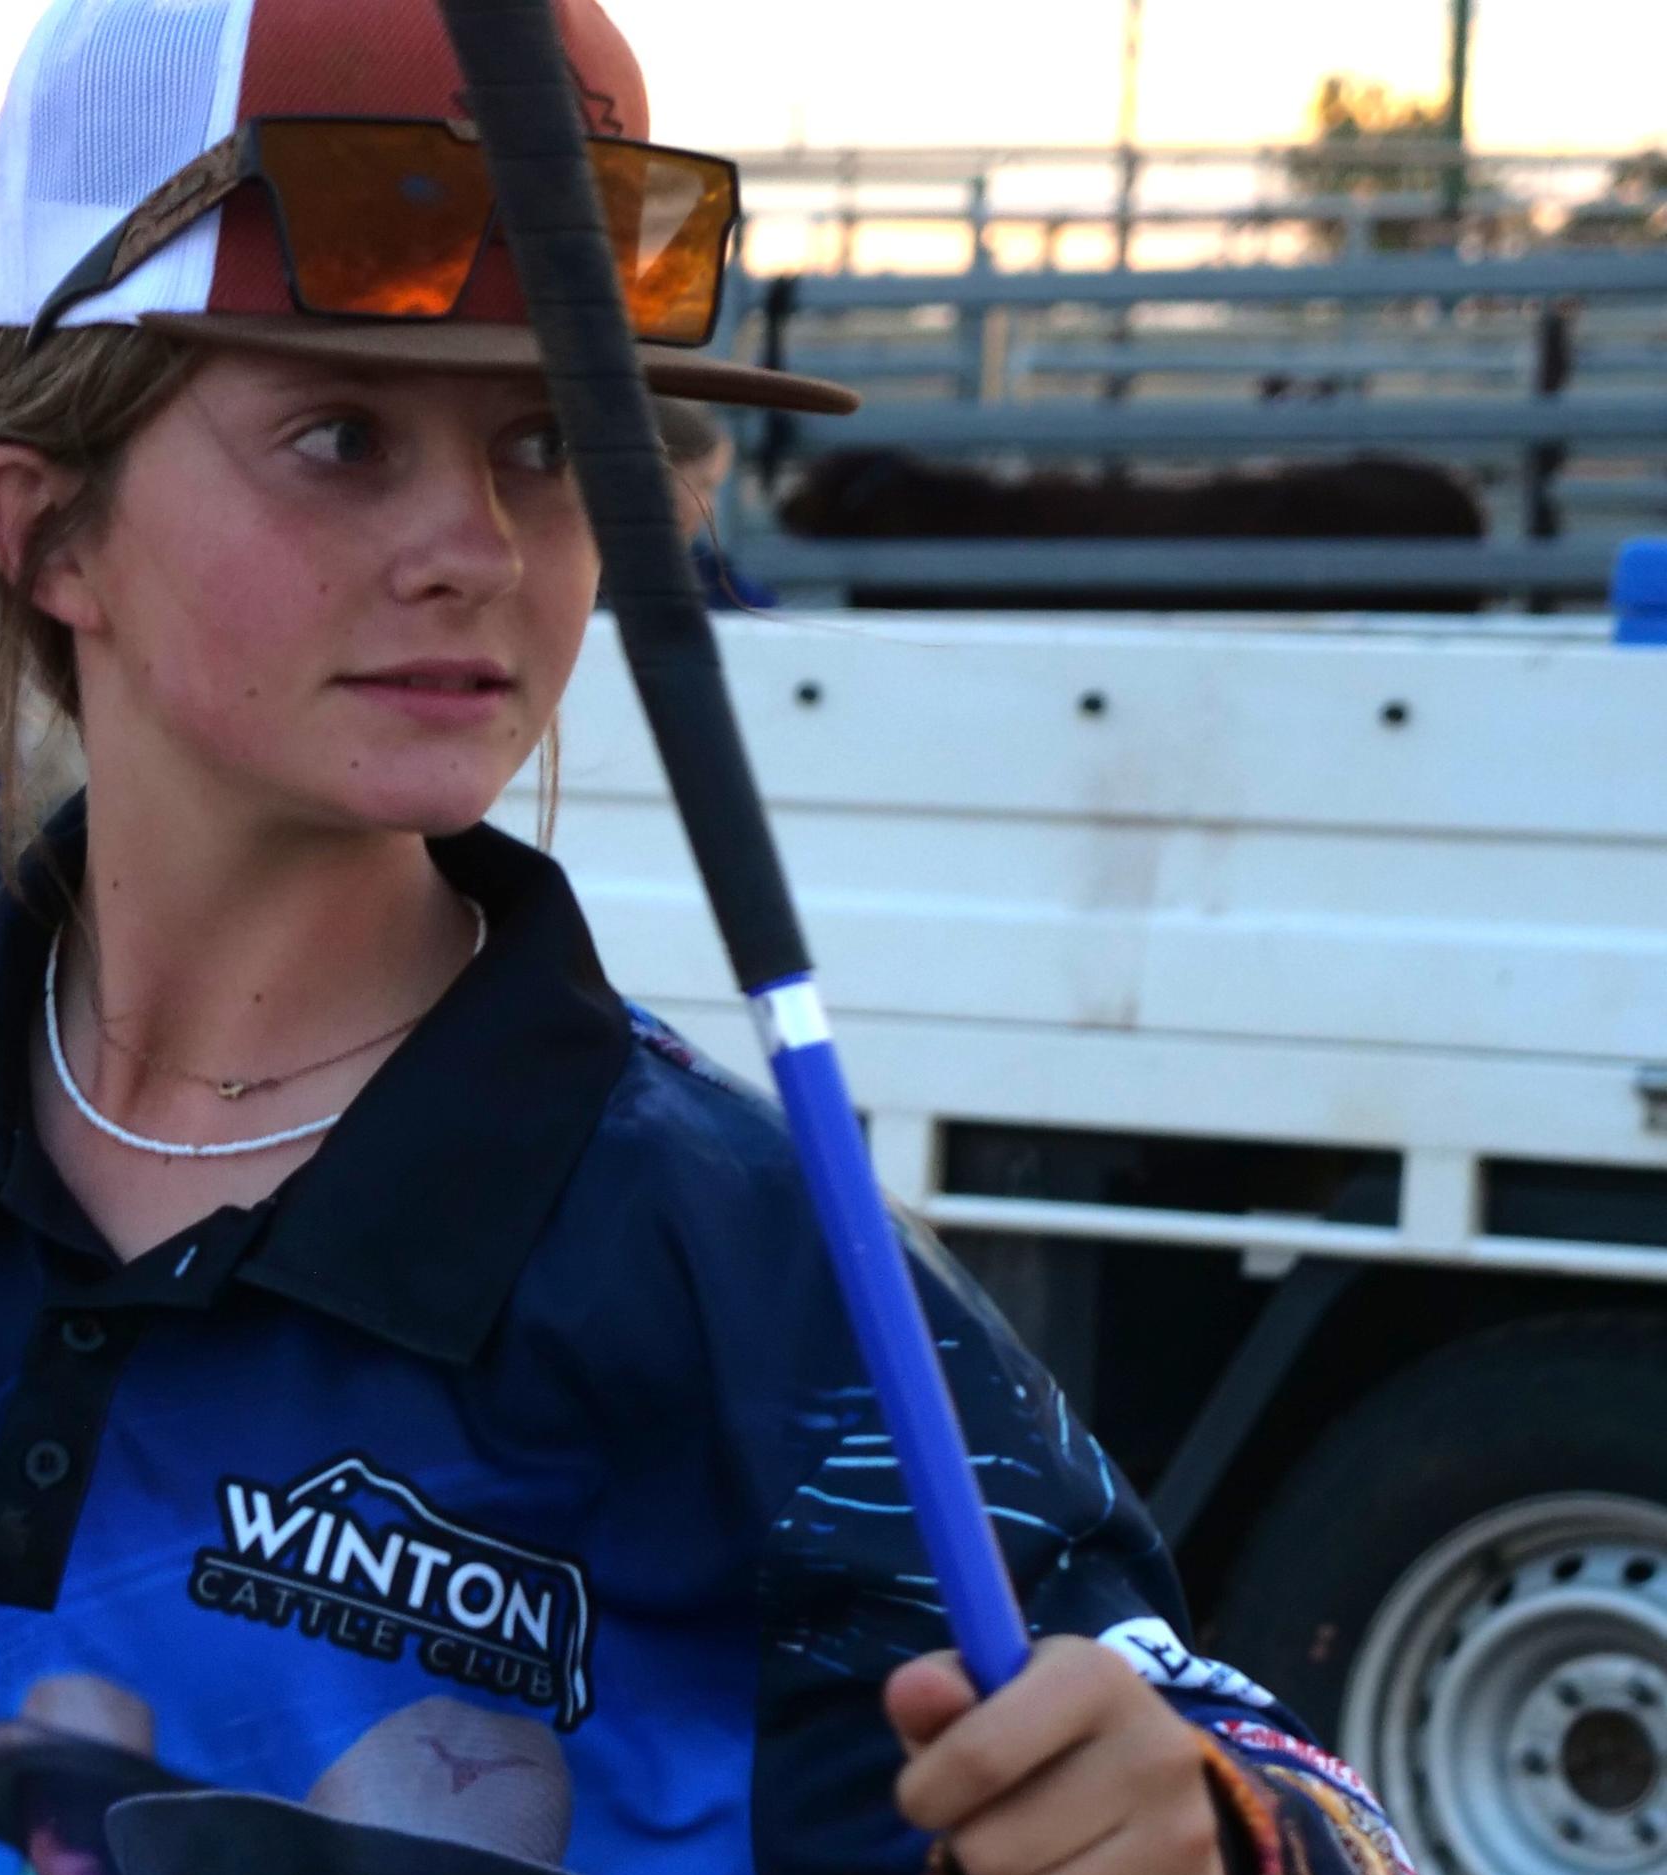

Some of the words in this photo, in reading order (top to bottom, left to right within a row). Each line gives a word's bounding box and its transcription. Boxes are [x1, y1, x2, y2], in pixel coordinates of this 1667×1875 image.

[195, 1568, 398, 1653] CATTLE
[427, 1637, 555, 1700] CLUB
[225, 1483, 553, 1651] WINTON
